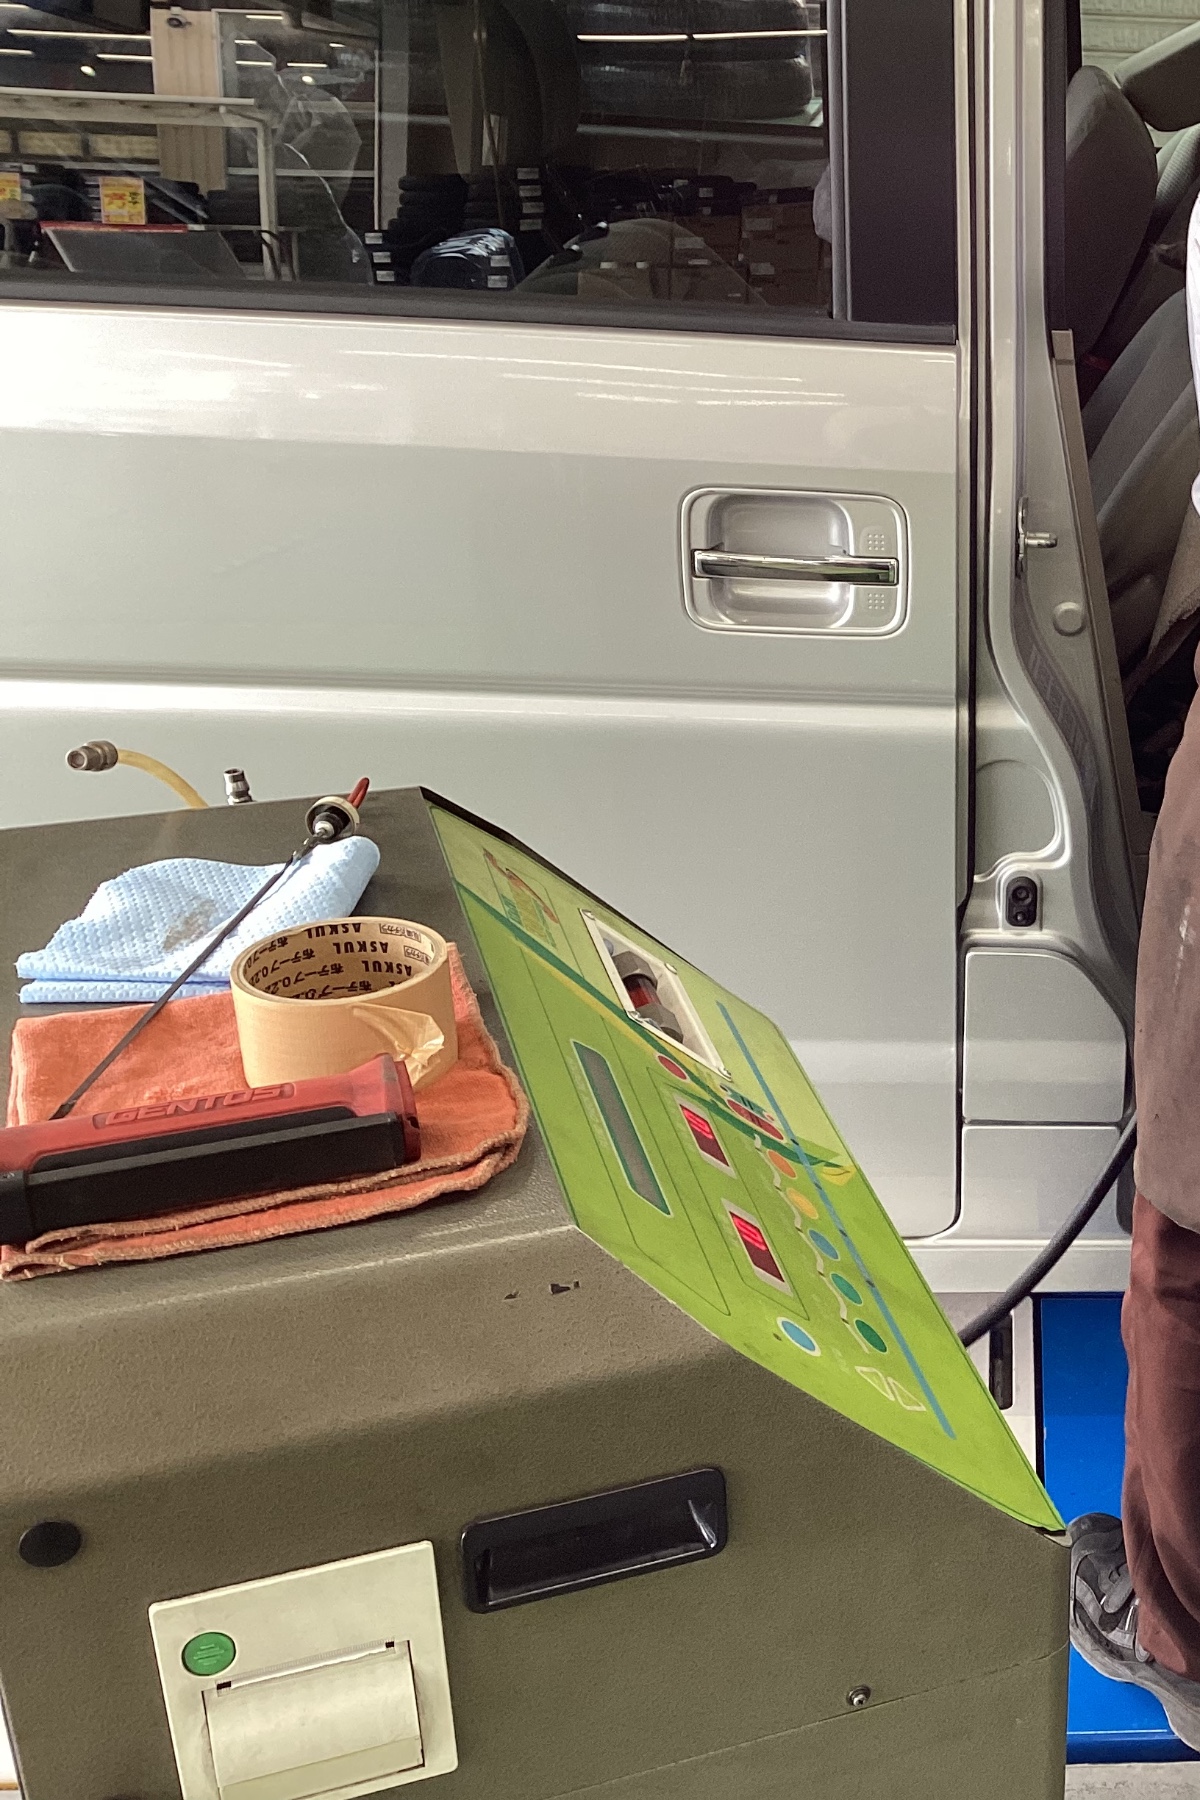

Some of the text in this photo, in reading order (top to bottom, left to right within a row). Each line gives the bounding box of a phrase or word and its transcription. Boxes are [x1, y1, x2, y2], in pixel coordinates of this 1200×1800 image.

[304, 923, 361, 938] ASKUL
[333, 941, 388, 954] ASKUL
[362, 961, 412, 977] ASKUL
[106, 1087, 281, 1126] GENTOS
